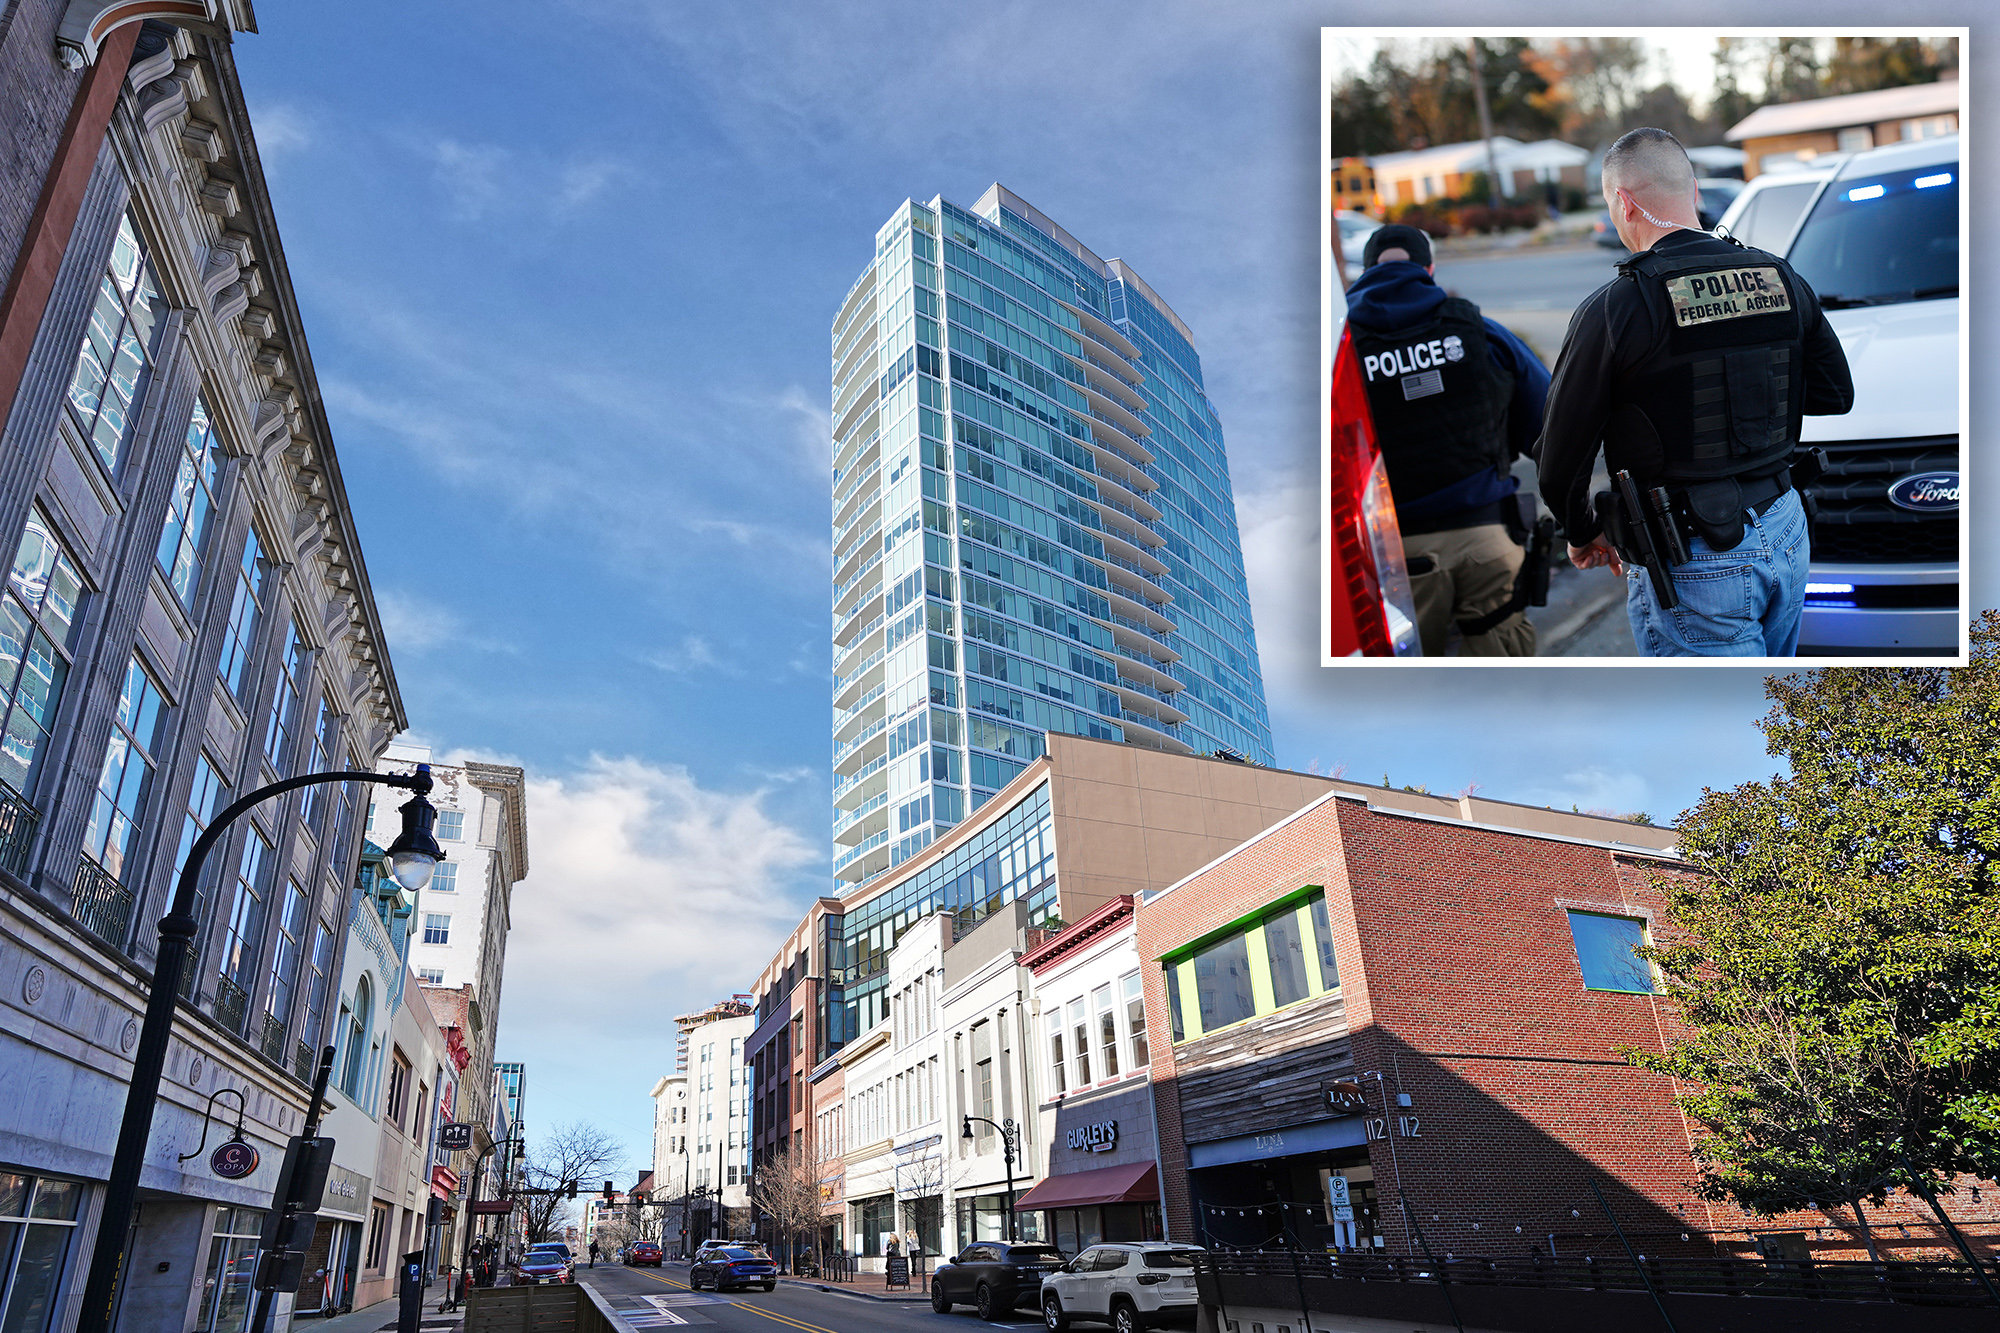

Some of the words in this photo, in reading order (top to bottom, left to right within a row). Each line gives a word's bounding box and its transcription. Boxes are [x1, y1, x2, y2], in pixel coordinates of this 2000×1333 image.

[1690, 271, 1767, 299] POLICE
[1680, 300, 1740, 322] FEDERAL
[1747, 294, 1785, 311] AGENT
[1364, 339, 1446, 382] POLICE
[1909, 478, 1959, 503] Ford
[1328, 1090, 1366, 1104] LUNA
[1366, 1118, 1387, 1140] 112
[1400, 1116, 1422, 1138] 112
[1255, 1133, 1284, 1150] LUNA
[216, 1162, 245, 1171] COPA
[226, 1148, 241, 1164] C
[411, 1264, 419, 1275] P
